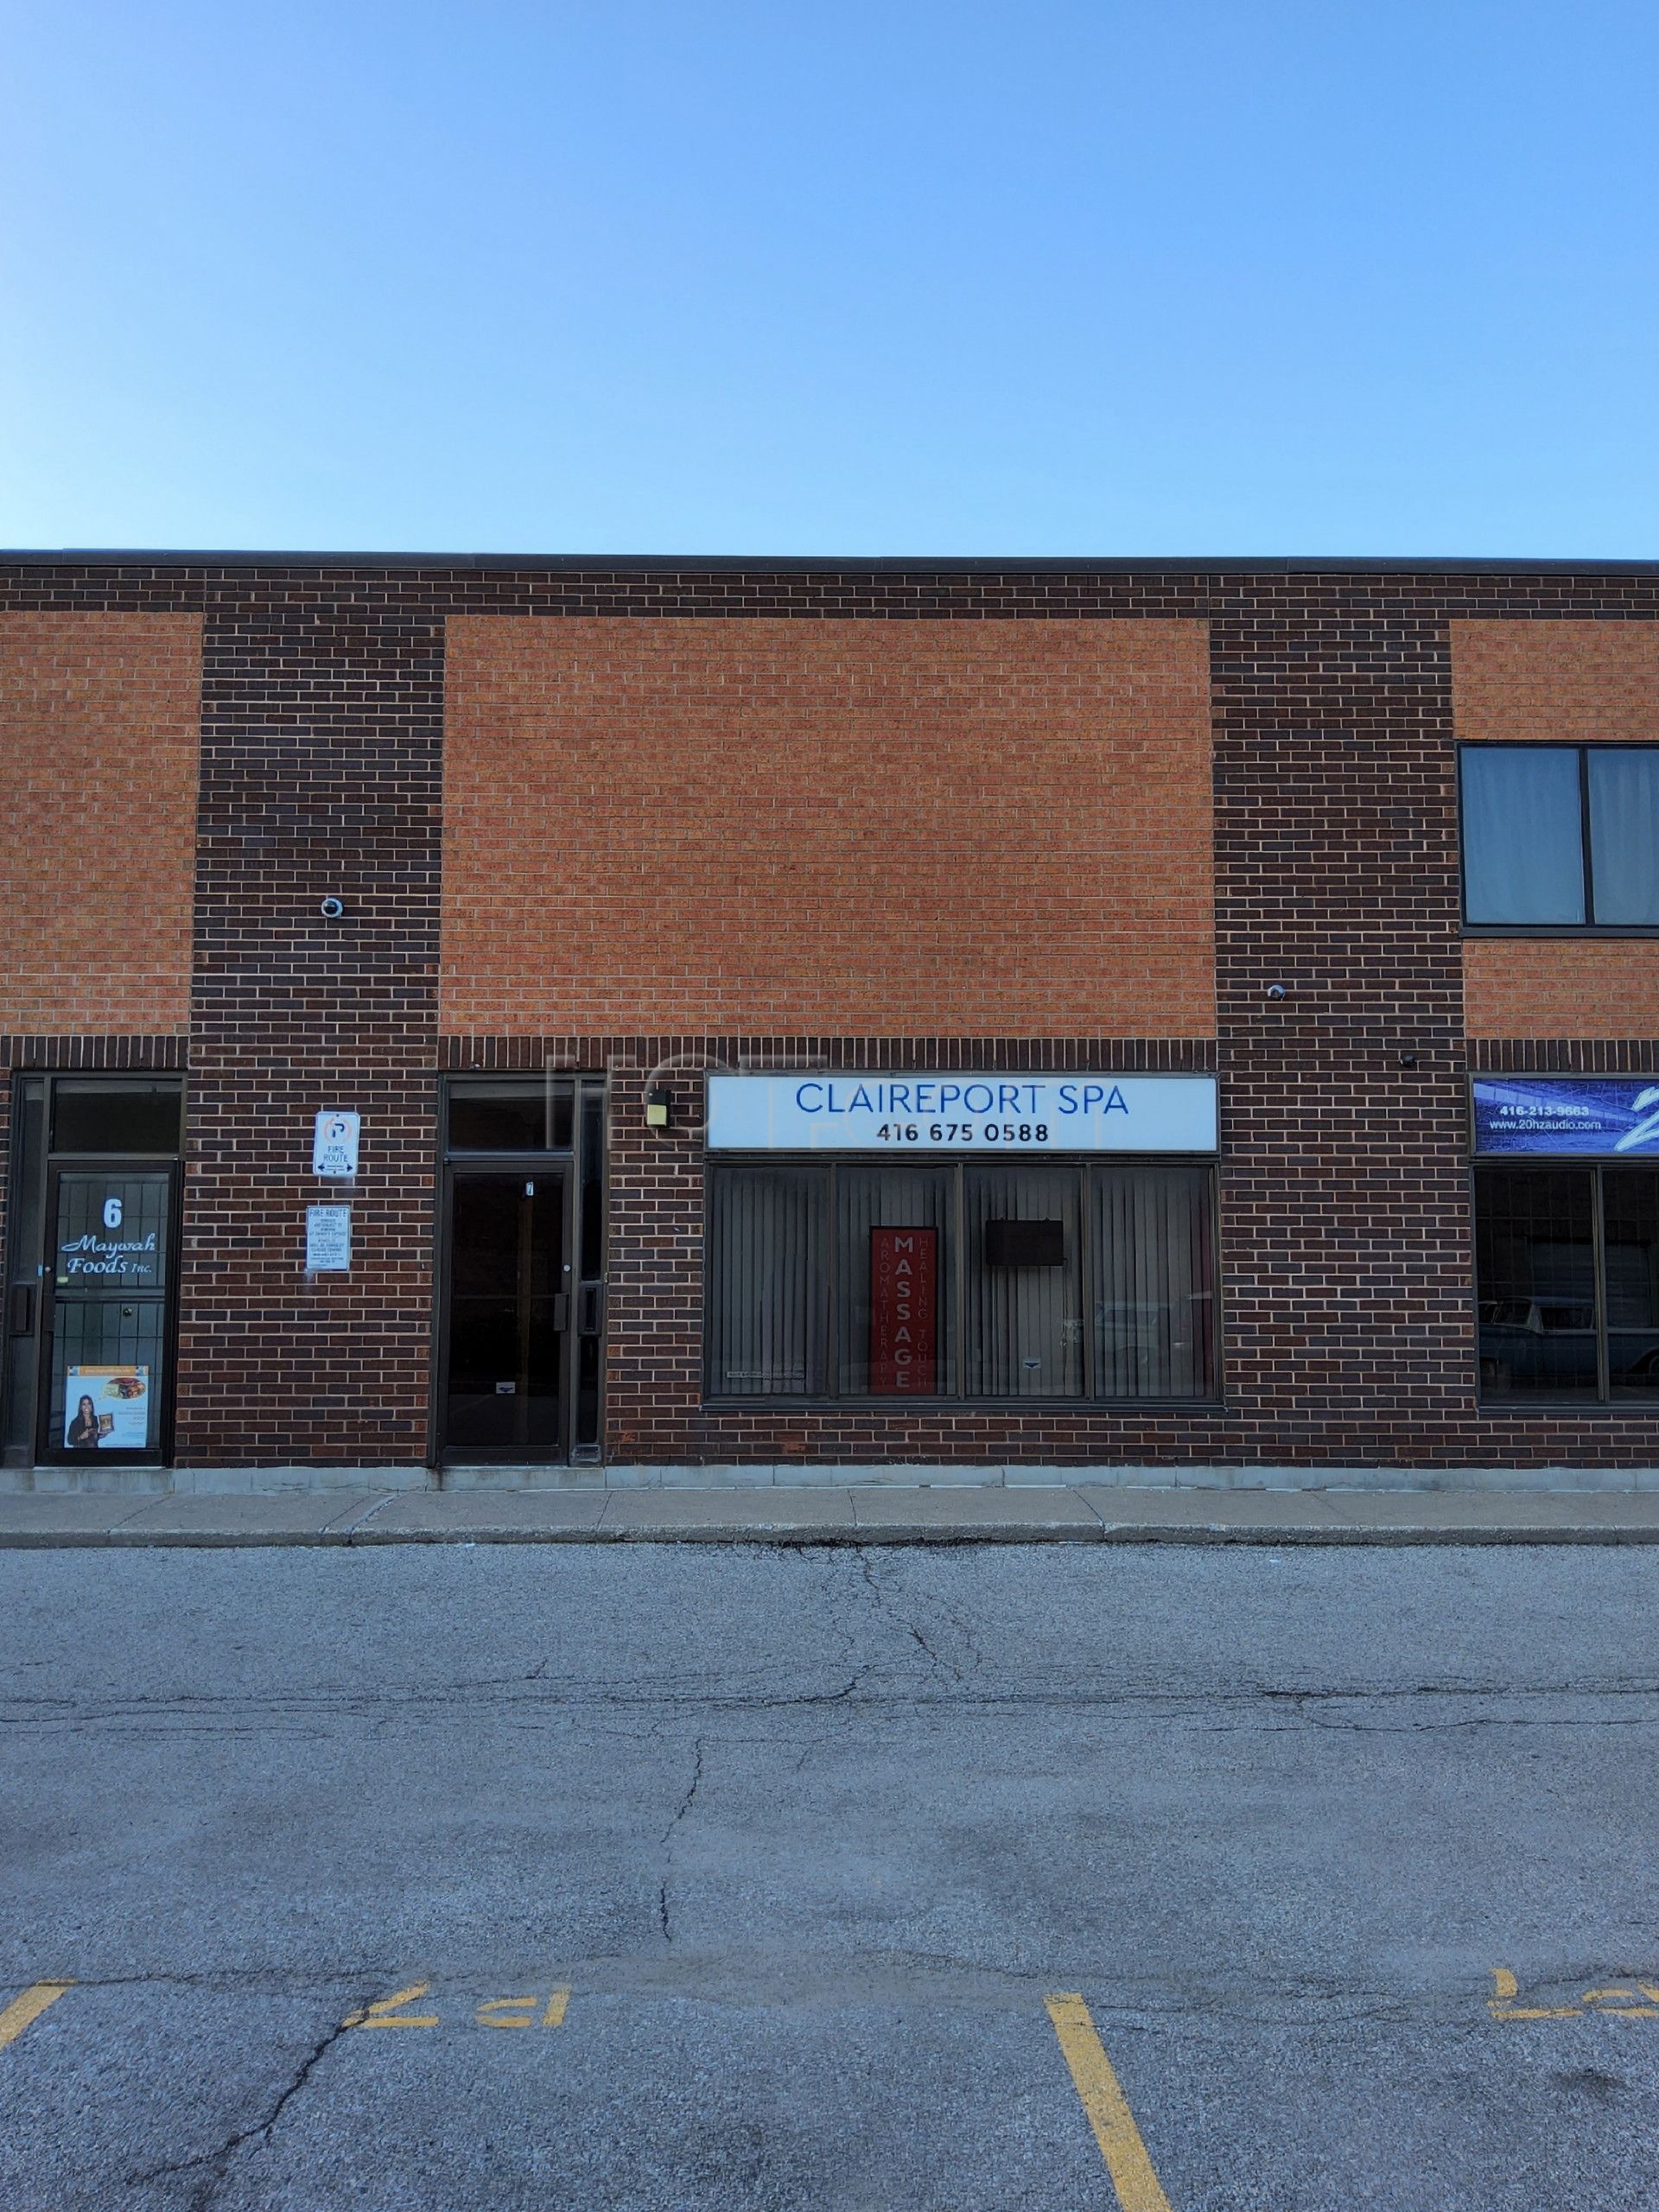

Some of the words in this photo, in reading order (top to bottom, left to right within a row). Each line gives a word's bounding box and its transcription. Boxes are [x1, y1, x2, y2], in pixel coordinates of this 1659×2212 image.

[797, 1084, 1046, 1114] CLAIREPORT
[1058, 1084, 1128, 1116] SPA
[876, 1124, 919, 1142] 416
[930, 1124, 973, 1142] 675
[983, 1124, 1049, 1142] 0588
[1490, 1120, 1602, 1129] www.20hzaudio.com
[323, 1154, 348, 1163] ROUTE
[104, 1198, 122, 1227] 6
[67, 1255, 128, 1274] Foods
[917, 1237, 929, 1319] HEALING
[879, 1237, 892, 1388] AROMATHERAPY
[894, 1236, 913, 1389] MASSAGE
[917, 1329, 929, 1388] TOUCH
